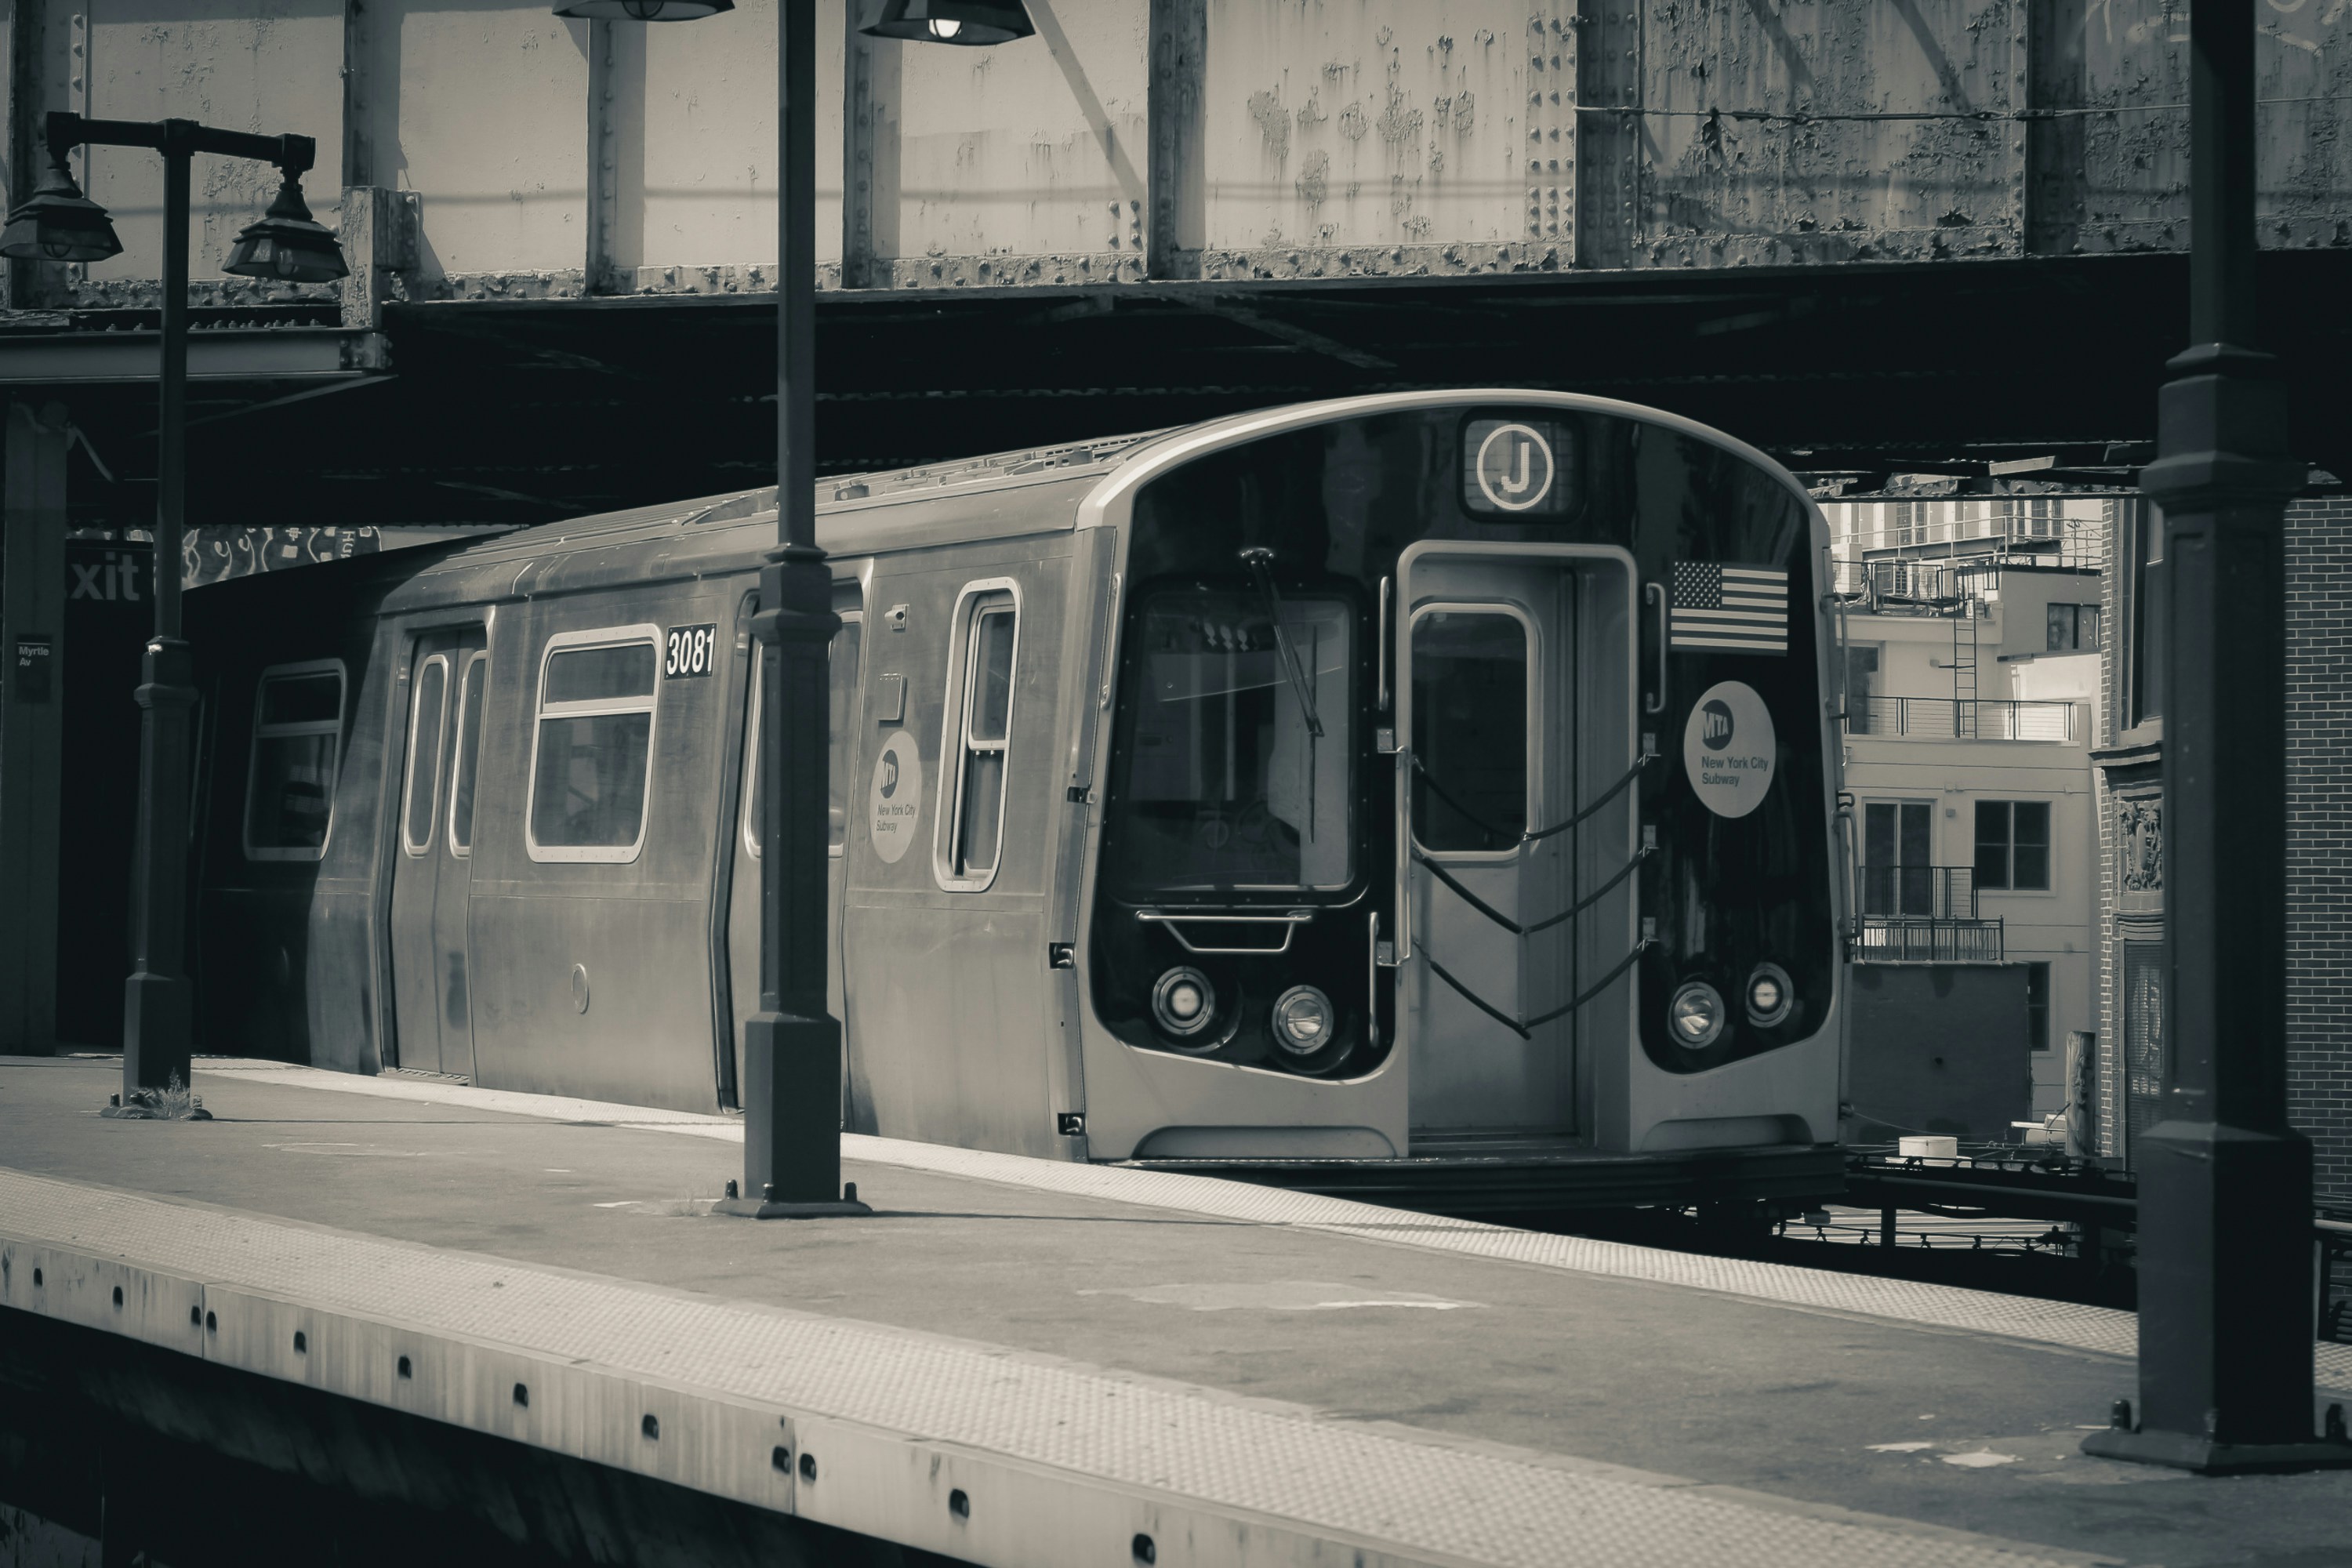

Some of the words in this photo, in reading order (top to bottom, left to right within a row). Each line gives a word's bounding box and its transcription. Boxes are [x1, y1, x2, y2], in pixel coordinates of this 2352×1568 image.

[1501, 442, 1530, 493] J
[66, 551, 140, 601] xit
[19, 646, 49, 656] Myrtle
[667, 628, 715, 674] 3081
[19, 658, 31, 666] Av
[1701, 710, 1729, 739] MTA
[1701, 756, 1724, 768] New
[1727, 757, 1748, 769] York
[1751, 757, 1769, 771] City
[880, 760, 895, 789] MTA
[1702, 772, 1740, 787] Subway
[878, 804, 890, 816] New
[891, 804, 903, 815] York
[905, 804, 916, 818] City
[877, 820, 898, 833] Subway
